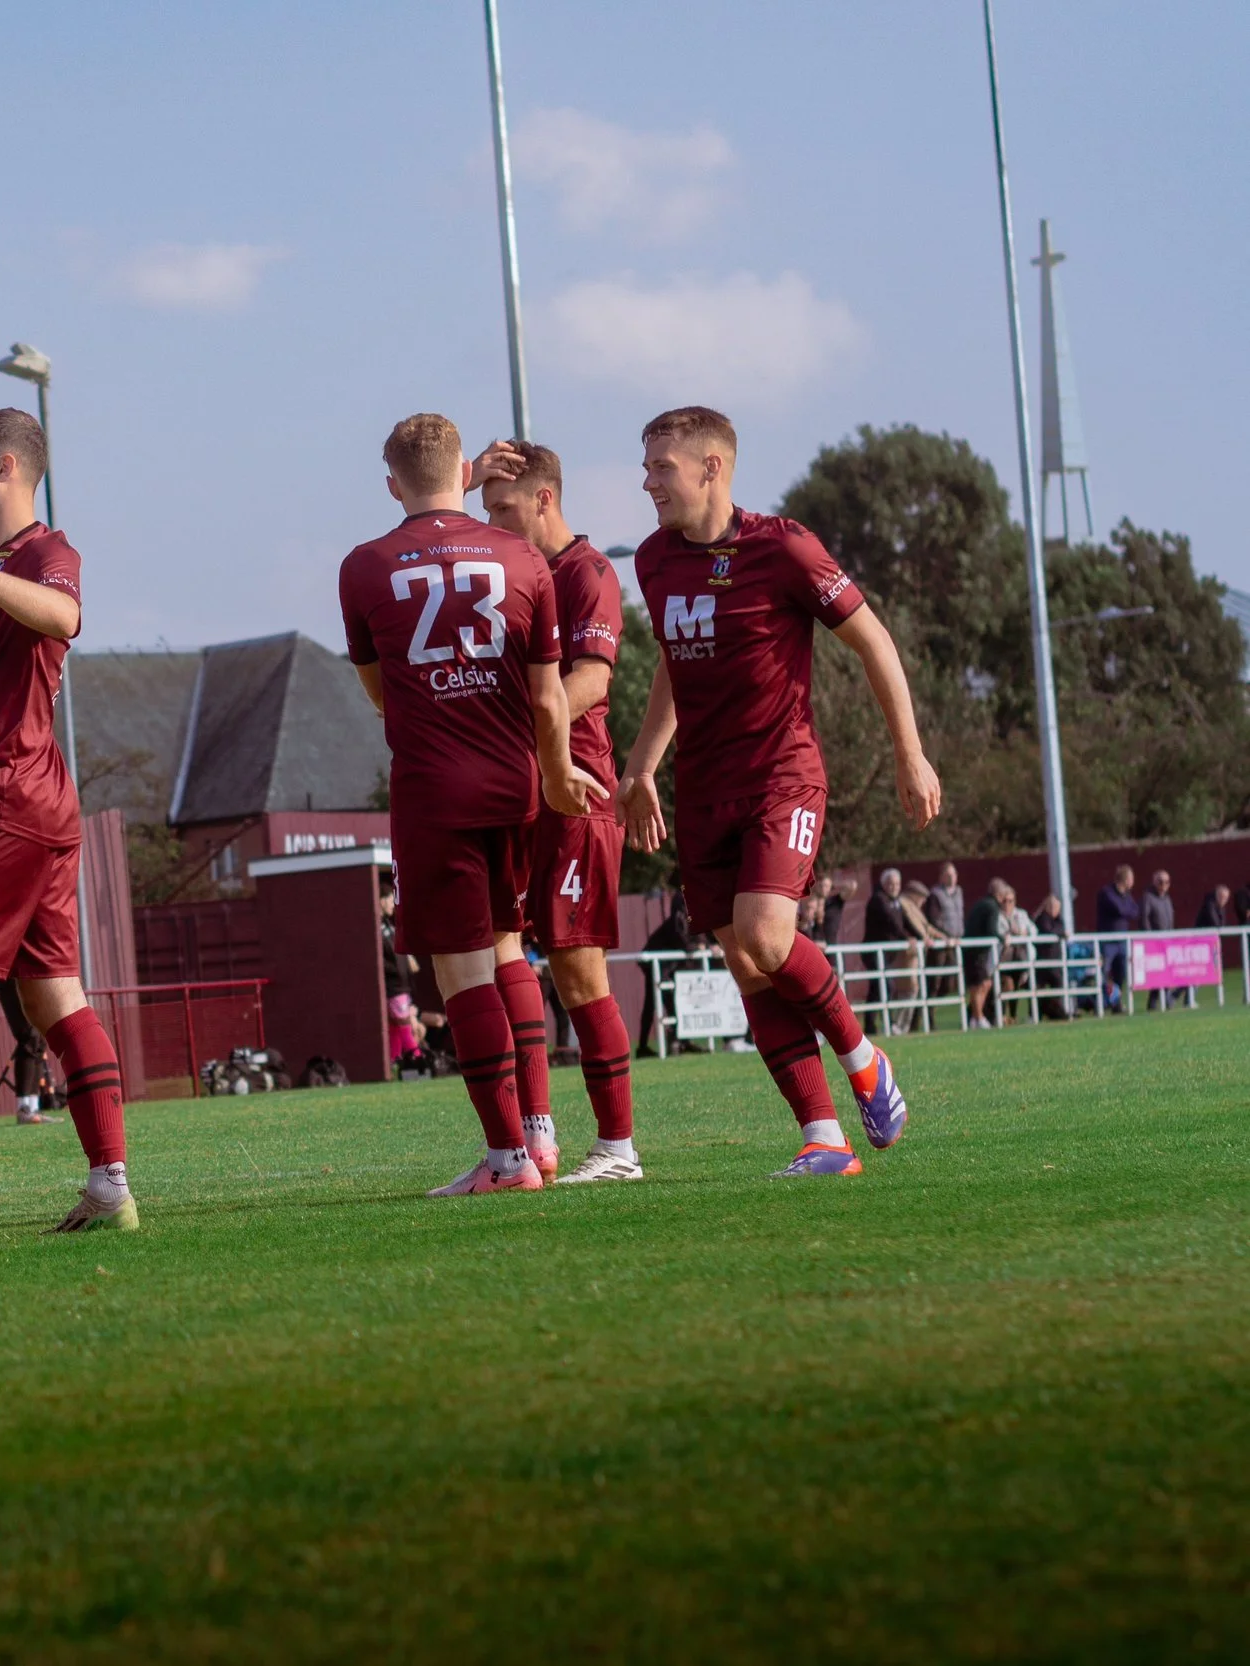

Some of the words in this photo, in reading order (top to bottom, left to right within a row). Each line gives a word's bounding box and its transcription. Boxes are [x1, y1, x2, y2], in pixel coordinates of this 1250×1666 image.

[428, 545, 493, 556] Watermans
[390, 561, 506, 665] 23
[664, 595, 716, 641] M
[670, 641, 716, 661] PACT
[430, 665, 498, 691] Celsius
[788, 807, 816, 856] 16
[560, 859, 583, 903] 4
